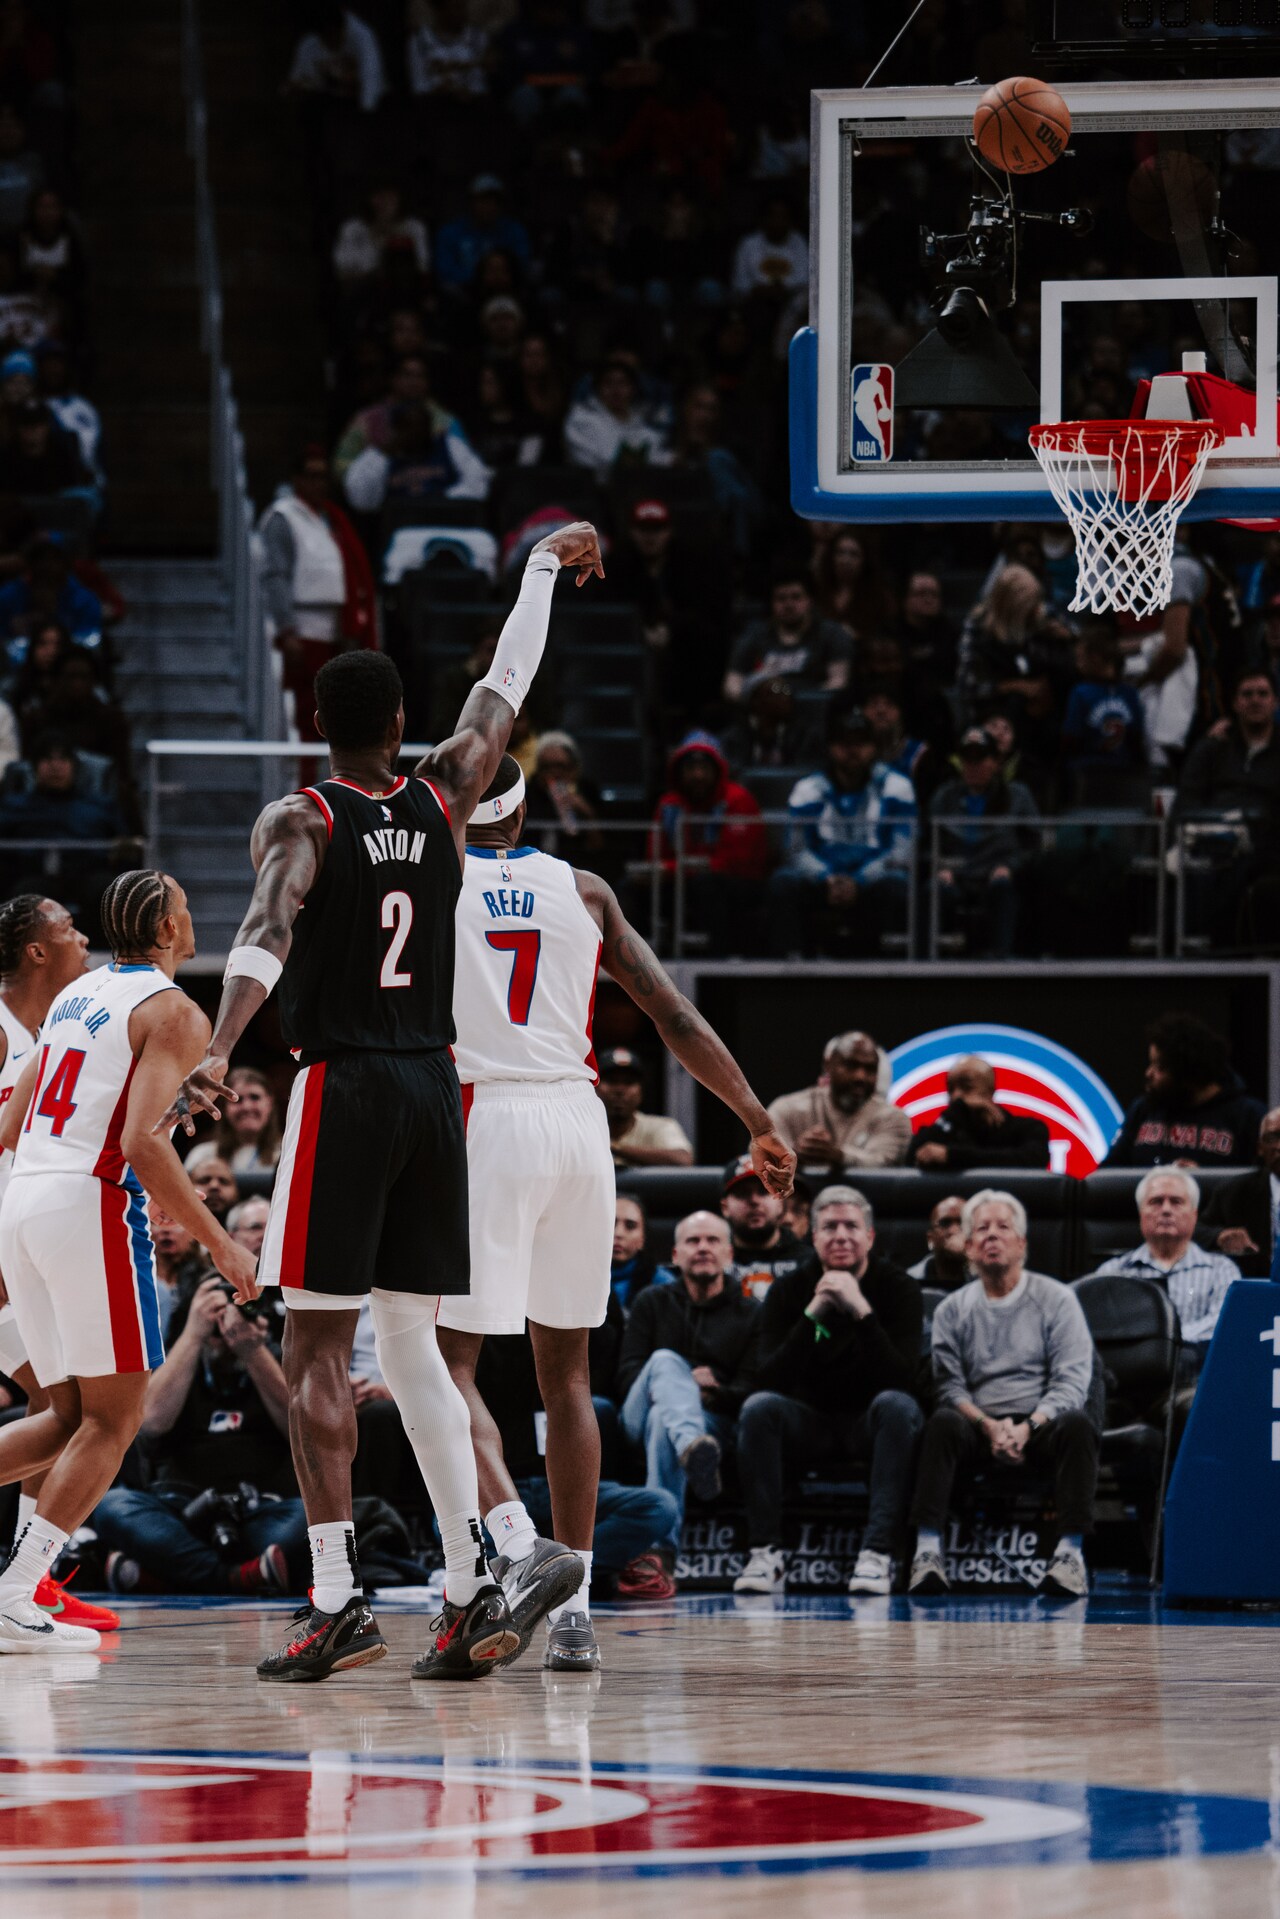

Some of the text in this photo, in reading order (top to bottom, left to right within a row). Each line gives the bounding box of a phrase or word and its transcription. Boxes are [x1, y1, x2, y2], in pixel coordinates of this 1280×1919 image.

[856, 441, 877, 457] NBA
[362, 828, 427, 865] AYTON
[482, 889, 535, 918] REED
[379, 890, 413, 989] 2
[484, 929, 541, 1026] 7
[49, 996, 111, 1039] MOORE JR.
[24, 1043, 87, 1138] 14
[681, 1519, 735, 1551] ttle
[797, 1522, 860, 1556] Litt
[945, 1521, 1039, 1556] Little
[674, 1551, 744, 1579] sars
[944, 1556, 1048, 1587] aesars
